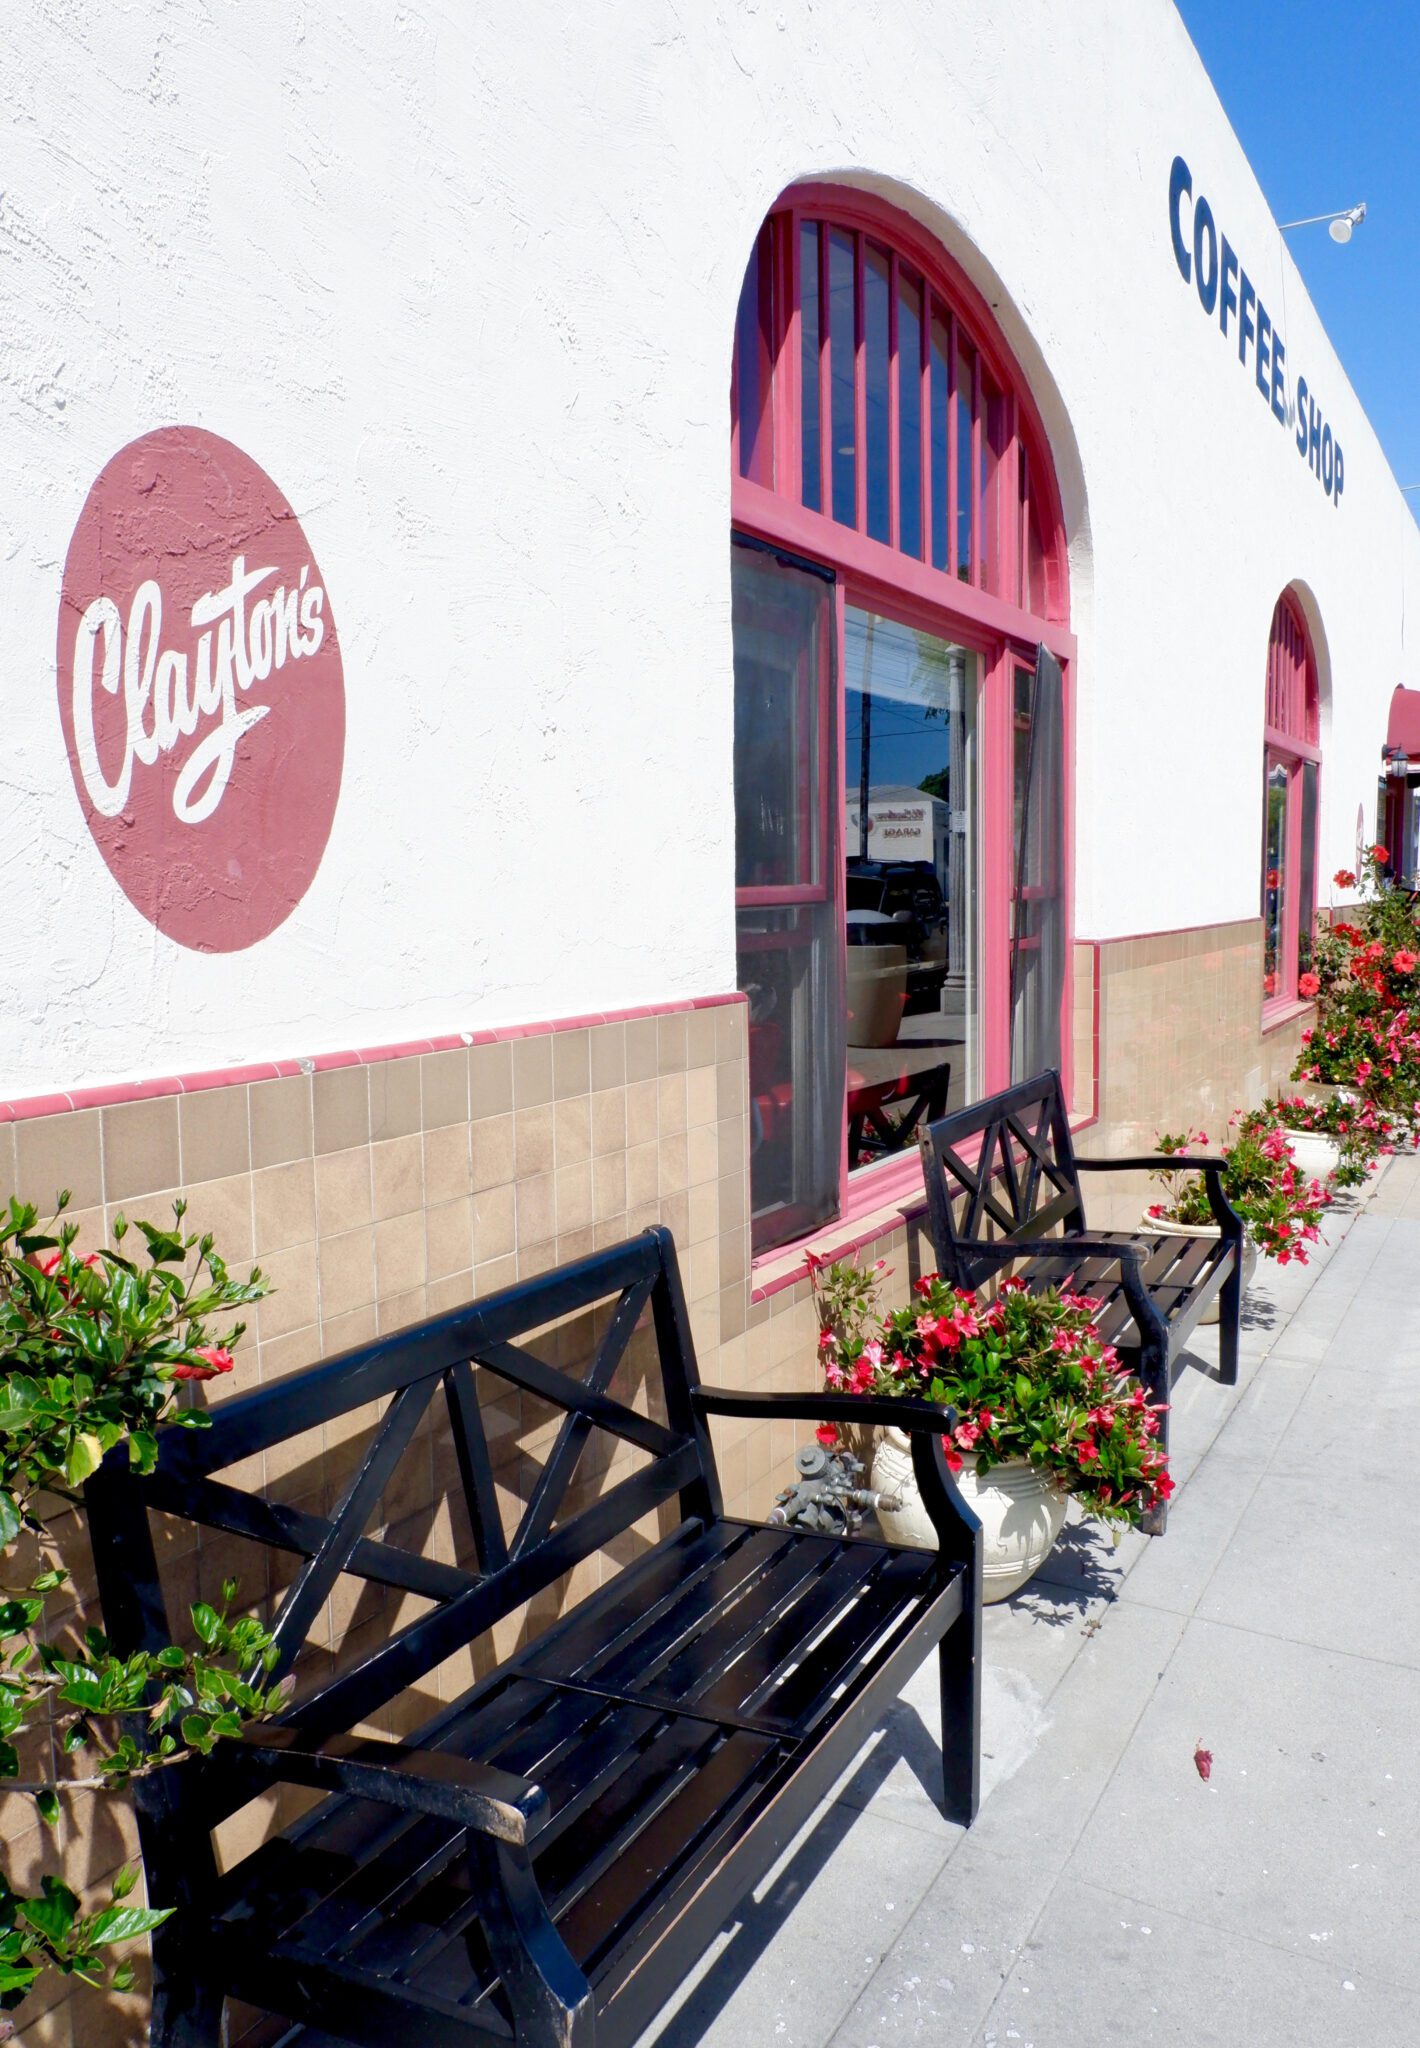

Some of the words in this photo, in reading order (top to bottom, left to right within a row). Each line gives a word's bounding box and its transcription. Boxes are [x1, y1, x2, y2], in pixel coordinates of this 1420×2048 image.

[1168, 155, 1285, 428] COFFEE
[1295, 375, 1345, 509] SHOP
[72, 555, 325, 824] Clayton's
